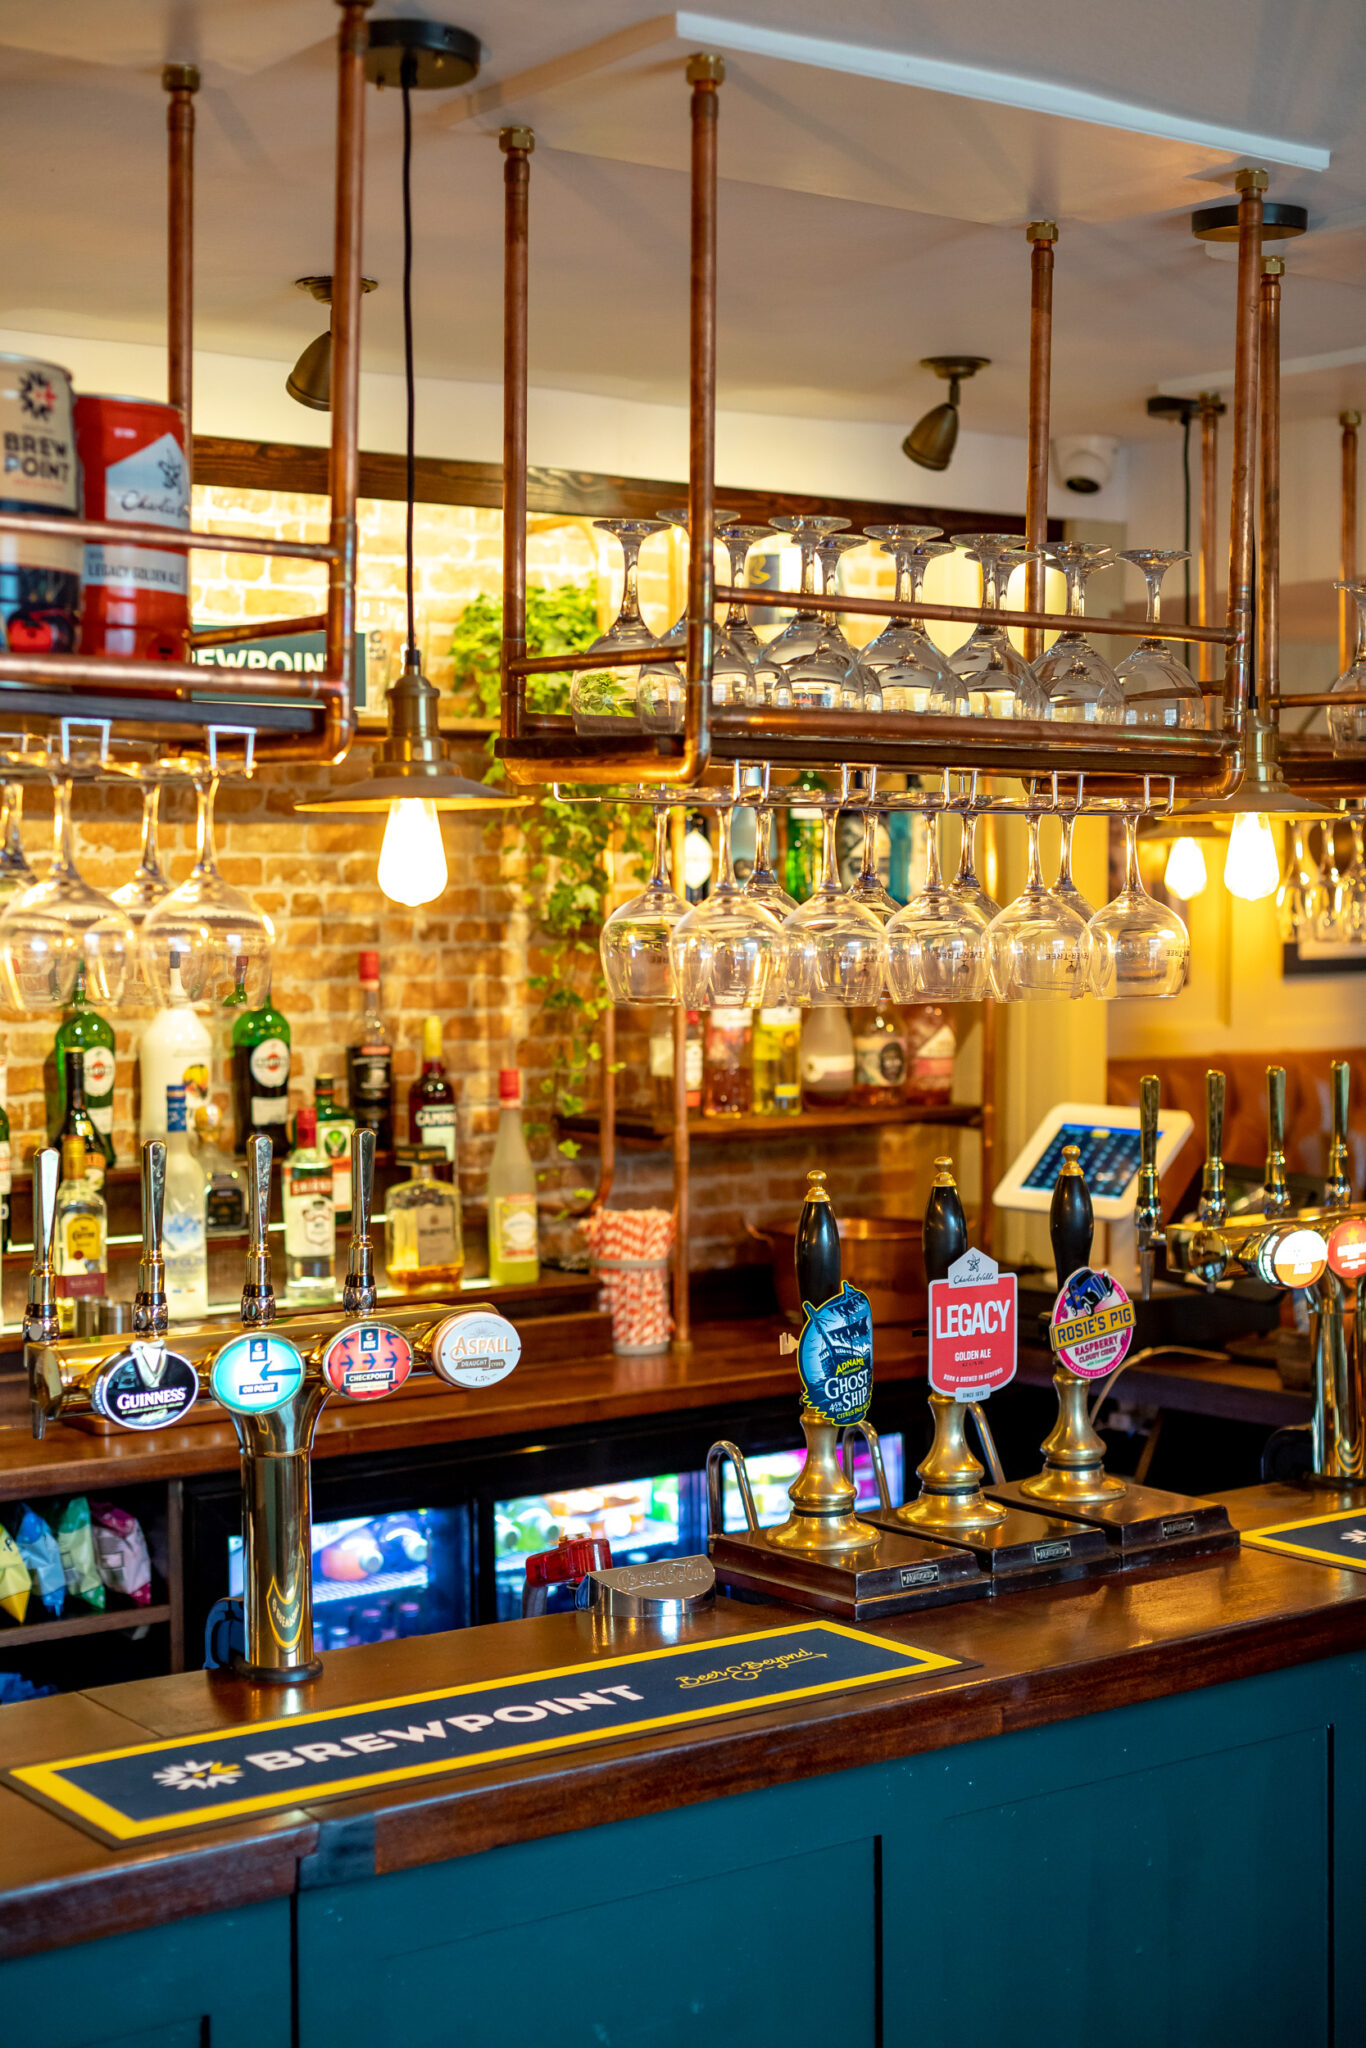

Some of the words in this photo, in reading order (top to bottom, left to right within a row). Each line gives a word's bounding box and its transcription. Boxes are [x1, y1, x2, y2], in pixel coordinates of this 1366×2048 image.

[4, 432, 68, 457] BREW
[4, 453, 70, 483] POINT
[88, 562, 129, 579] LEGACY
[936, 1299, 1011, 1339] LEGACY
[450, 1336, 513, 1362] ASPALL
[954, 1349, 979, 1361] GOLDEN
[980, 1348, 992, 1359] ALE
[1074, 1335, 1118, 1356] RASPBERRY
[461, 1360, 487, 1368] DRAUGHT
[835, 1357, 865, 1376] ADNAMS
[1078, 1351, 1100, 1363] CLOUDY
[348, 1372, 391, 1382] CHECKPOINT
[824, 1368, 869, 1400] GHOST
[943, 1373, 955, 1381] BORN
[254, 1383, 276, 1393] POINT
[117, 1388, 187, 1410] GUINNESS
[842, 1386, 868, 1412] SHIP
[675, 1670, 728, 1688] Beer
[741, 1648, 813, 1669] Beyond
[245, 1684, 645, 1772] BREWPOINT
